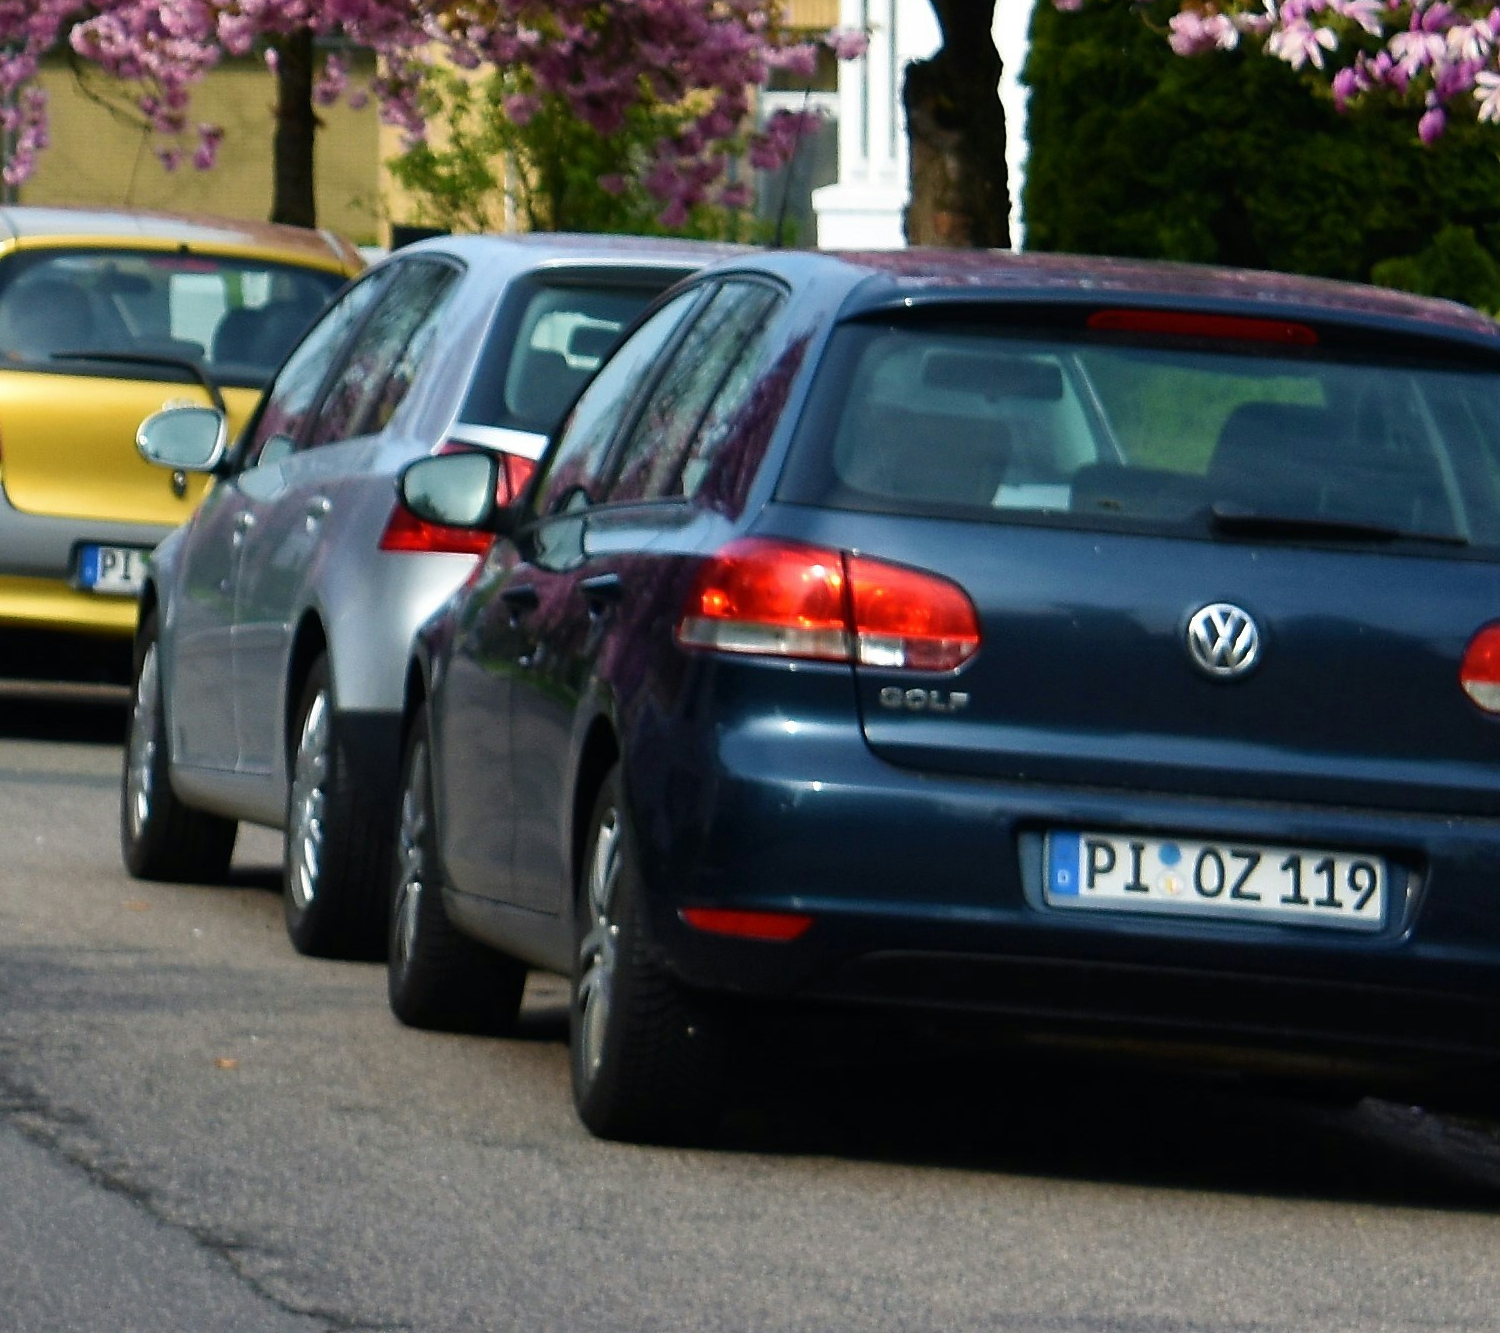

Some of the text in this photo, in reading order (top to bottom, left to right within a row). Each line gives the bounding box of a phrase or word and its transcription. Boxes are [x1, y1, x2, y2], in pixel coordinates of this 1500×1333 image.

[101, 549, 133, 581] PI
[1188, 603, 1258, 675] VW
[880, 686, 969, 711] GOLF
[1085, 840, 1378, 912] PI OZ 119
